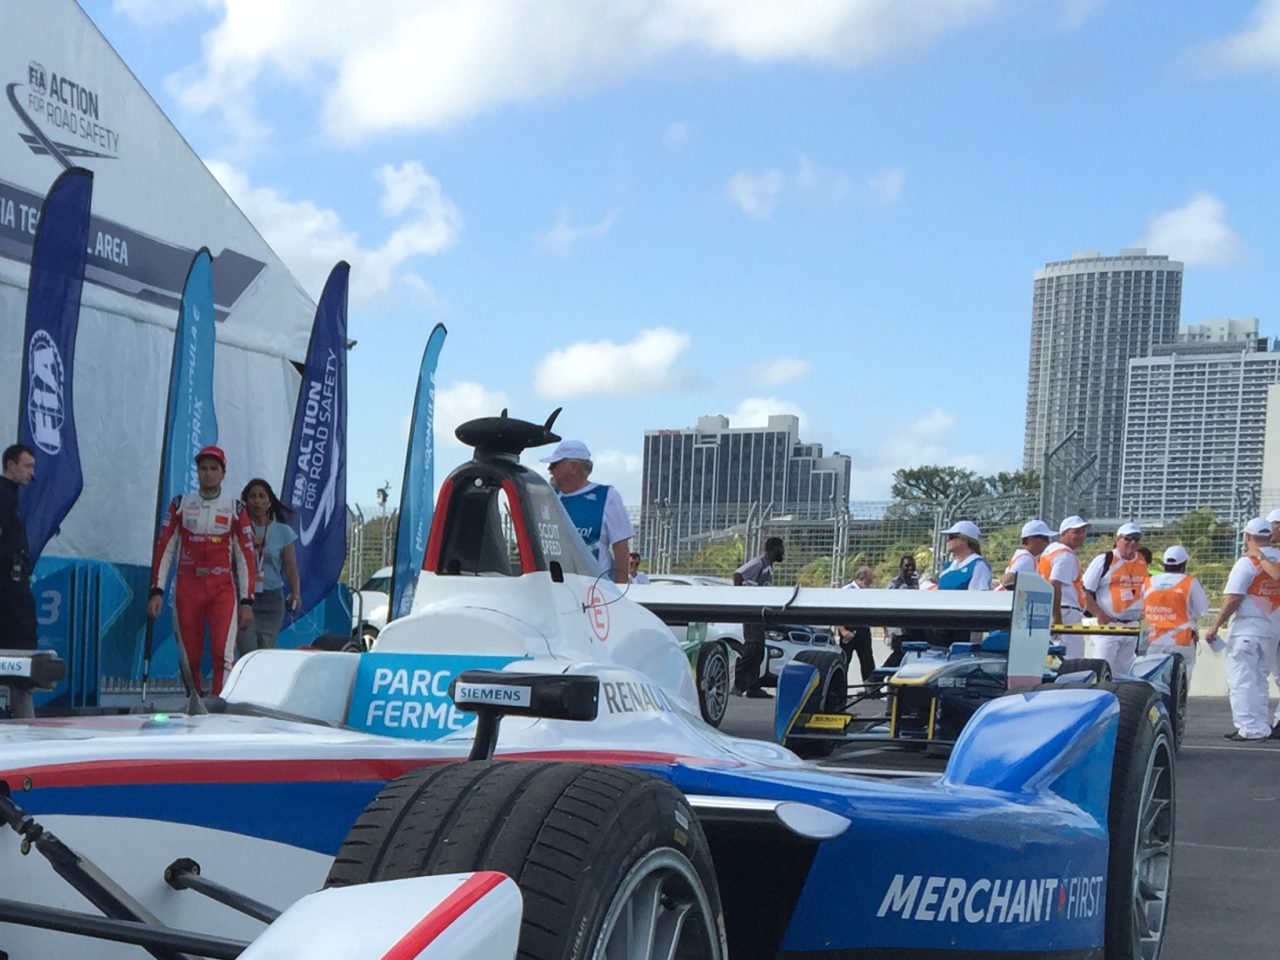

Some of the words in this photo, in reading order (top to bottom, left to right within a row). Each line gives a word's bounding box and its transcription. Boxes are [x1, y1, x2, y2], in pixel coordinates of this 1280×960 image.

[49, 72, 99, 120] ACTION
[28, 93, 45, 114] FOR
[46, 102, 77, 134] ROAD
[79, 117, 120, 153] SAFETY
[94, 231, 129, 267] AREA
[319, 348, 337, 423] SAFETY
[297, 380, 322, 471] ACTION
[310, 426, 329, 480] ROAD
[304, 482, 318, 510] FOR
[537, 522, 560, 540] SCOTT
[540, 539, 562, 556] SPEED
[371, 667, 451, 697] PARC
[459, 686, 521, 702] SIEMENS
[876, 873, 1058, 924] MERCHANT
[1066, 875, 1104, 920] FIRST
